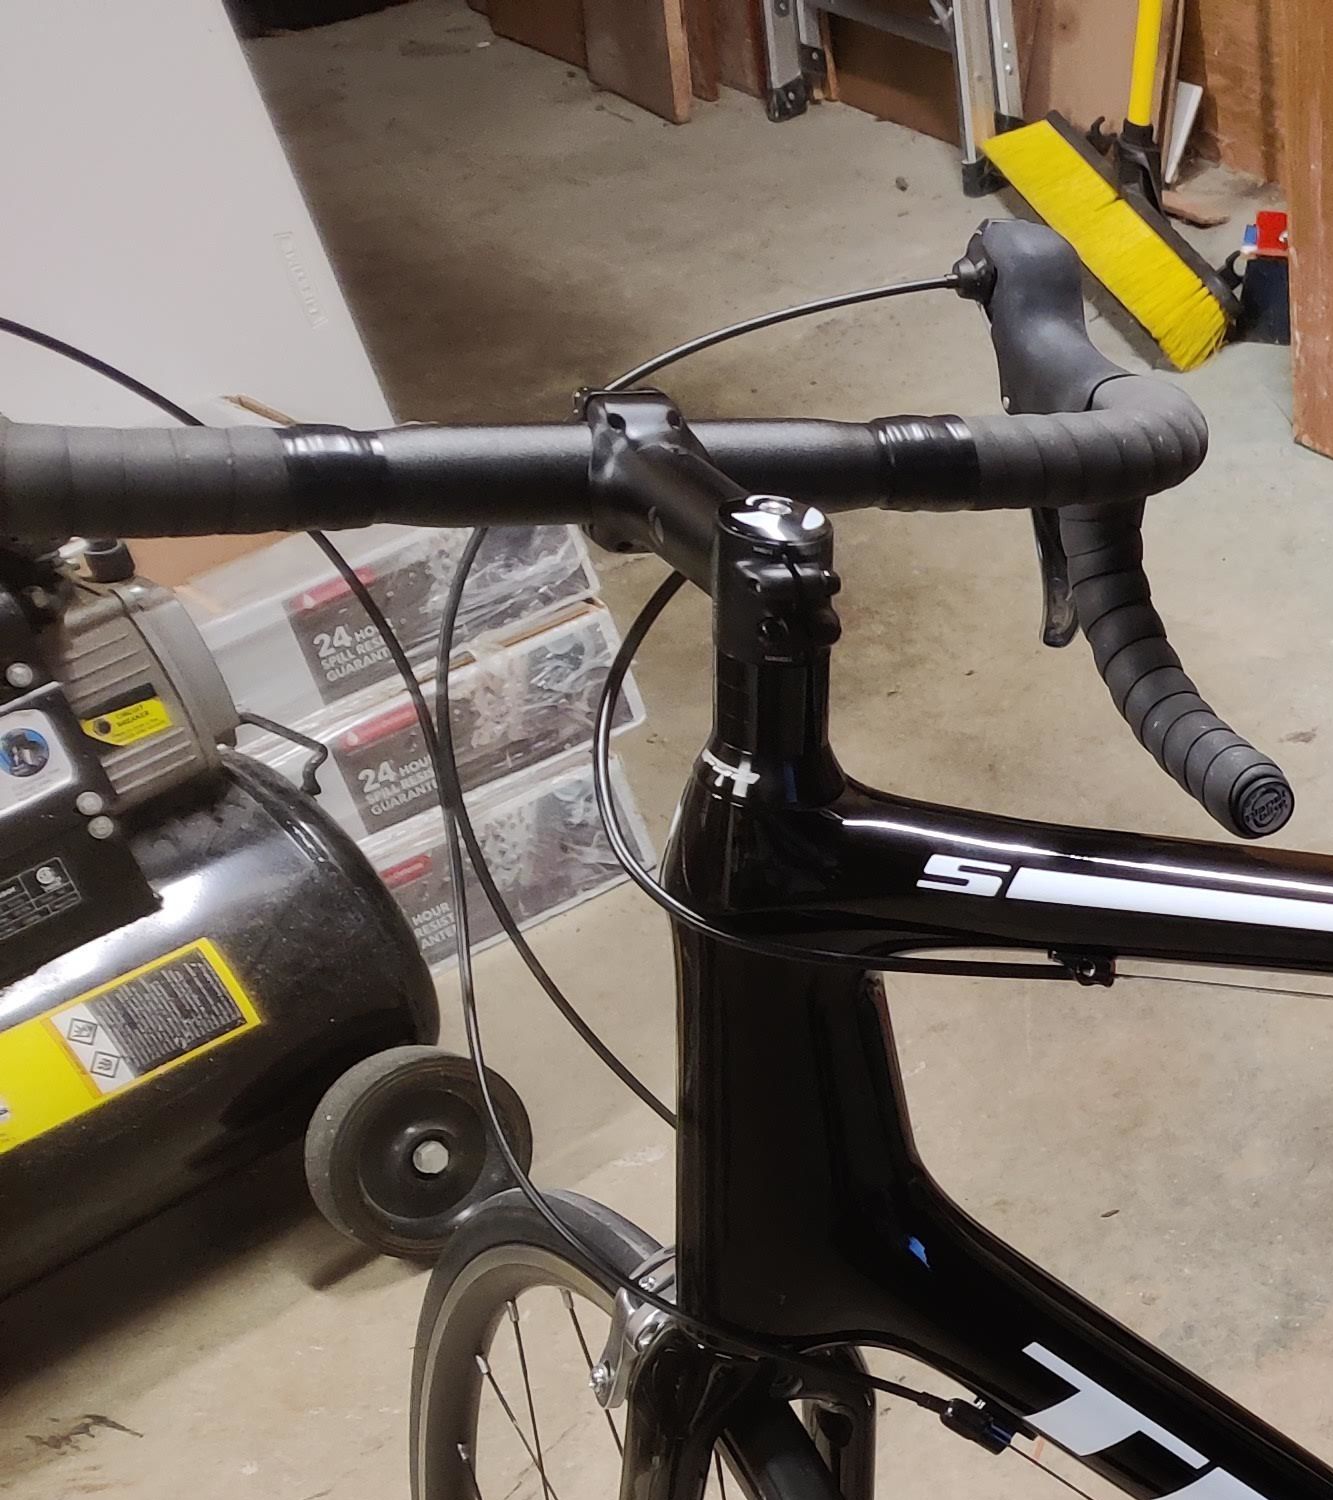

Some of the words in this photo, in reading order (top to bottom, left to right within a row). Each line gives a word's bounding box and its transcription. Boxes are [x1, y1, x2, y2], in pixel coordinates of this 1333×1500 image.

[313, 624, 352, 658] 24
[358, 760, 397, 793] 24
[411, 902, 450, 926] HOUR
